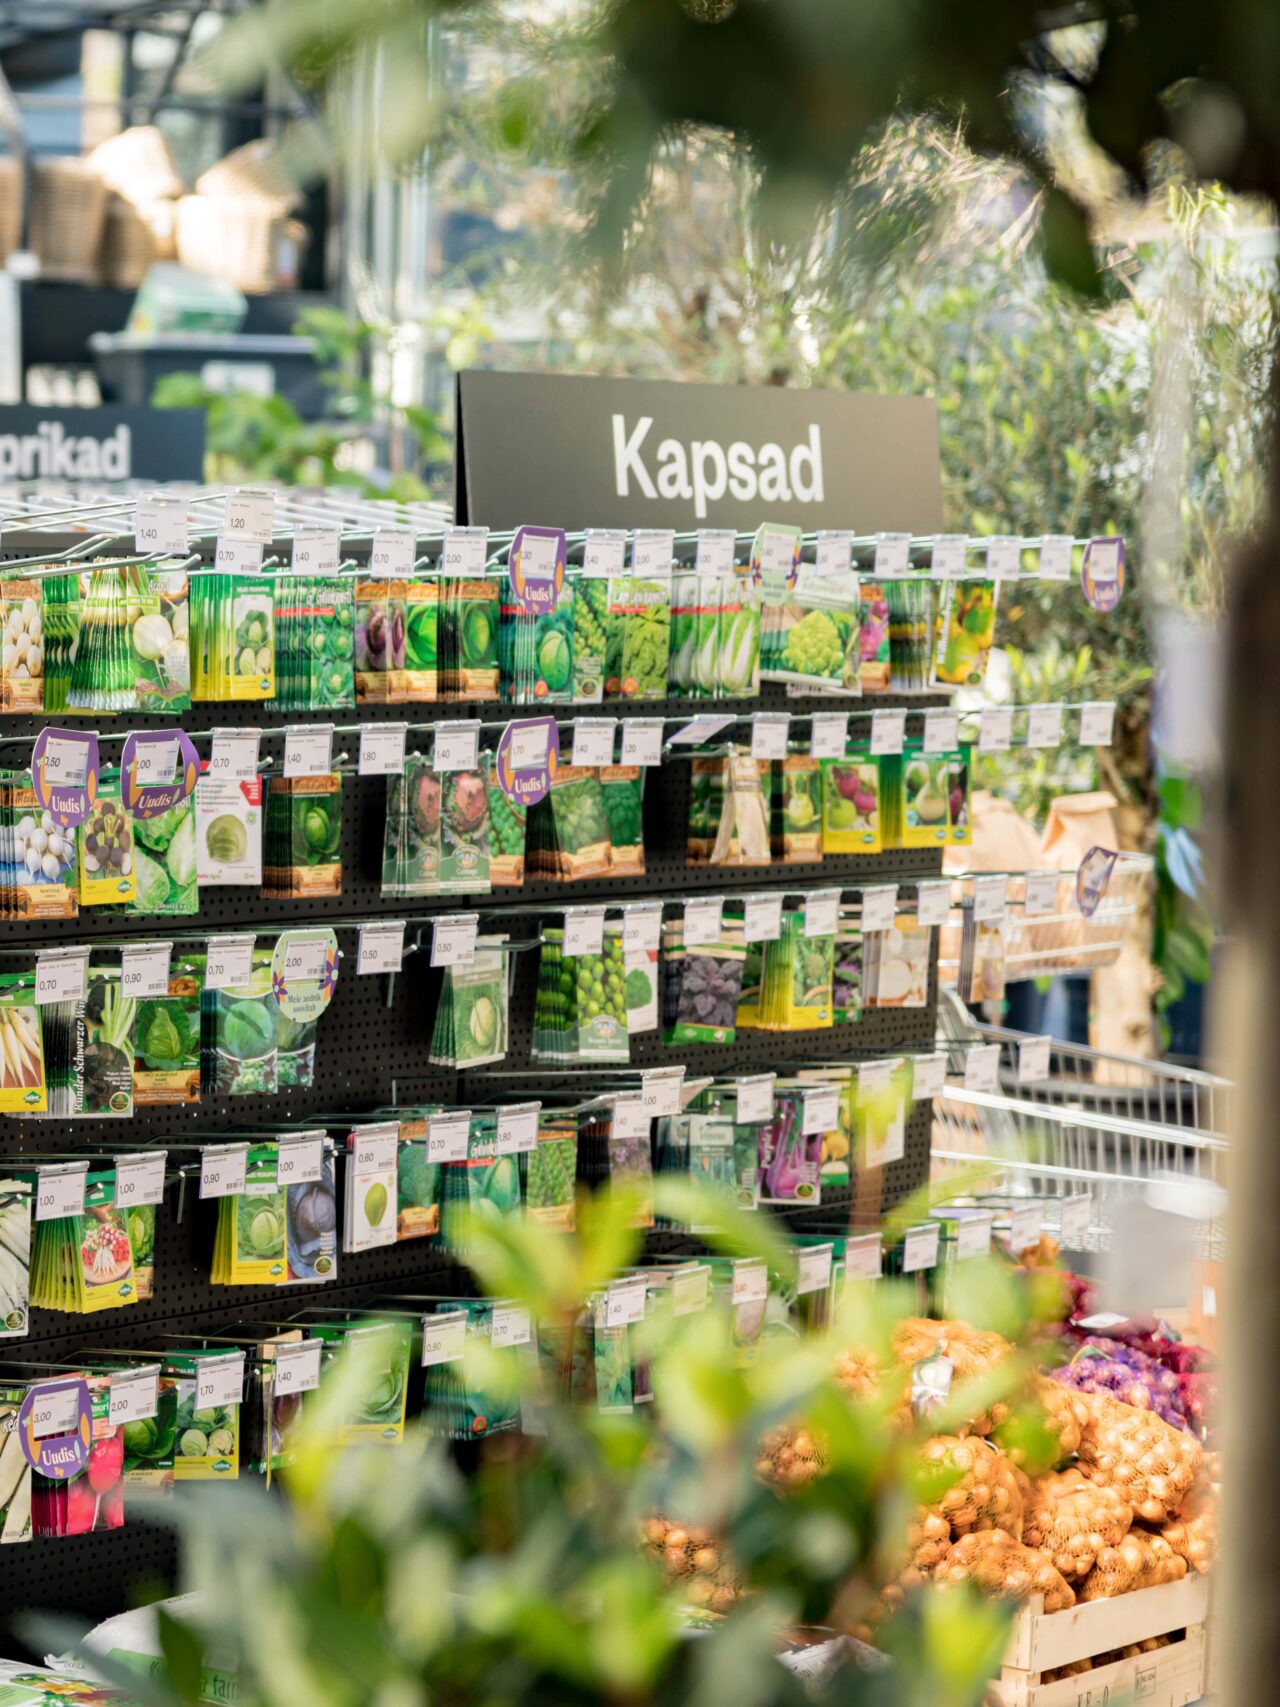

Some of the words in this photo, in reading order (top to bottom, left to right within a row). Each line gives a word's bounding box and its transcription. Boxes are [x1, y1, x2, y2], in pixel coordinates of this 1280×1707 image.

[612, 414, 825, 519] Kapsad
[141, 529, 157, 539] 1,40
[219, 551, 234, 560] 0,70
[293, 552, 309, 561] 1,40
[285, 754, 301, 763] 1,40
[361, 749, 376, 761] 1,80
[435, 750, 450, 758] 1,40
[211, 758, 229, 768] 0,70
[286, 958, 302, 967] 2,00
[206, 963, 224, 975] 0,70
[123, 973, 141, 983] 0,90
[40, 980, 56, 990] 0,70
[72, 1021, 85, 1073] Schwarzer
[496, 1129, 511, 1143] 1,80
[428, 1137, 445, 1150] 0,70
[278, 1159, 293, 1172] 1,00
[202, 1173, 219, 1184] 0,90
[117, 1183, 135, 1194] 1,00
[38, 1193, 54, 1206] 1,00
[275, 1369, 291, 1382] 1,40
[198, 1385, 213, 1395] 1,70
[109, 1398, 128, 1412] 2,00
[32, 1411, 51, 1423] 3,00
